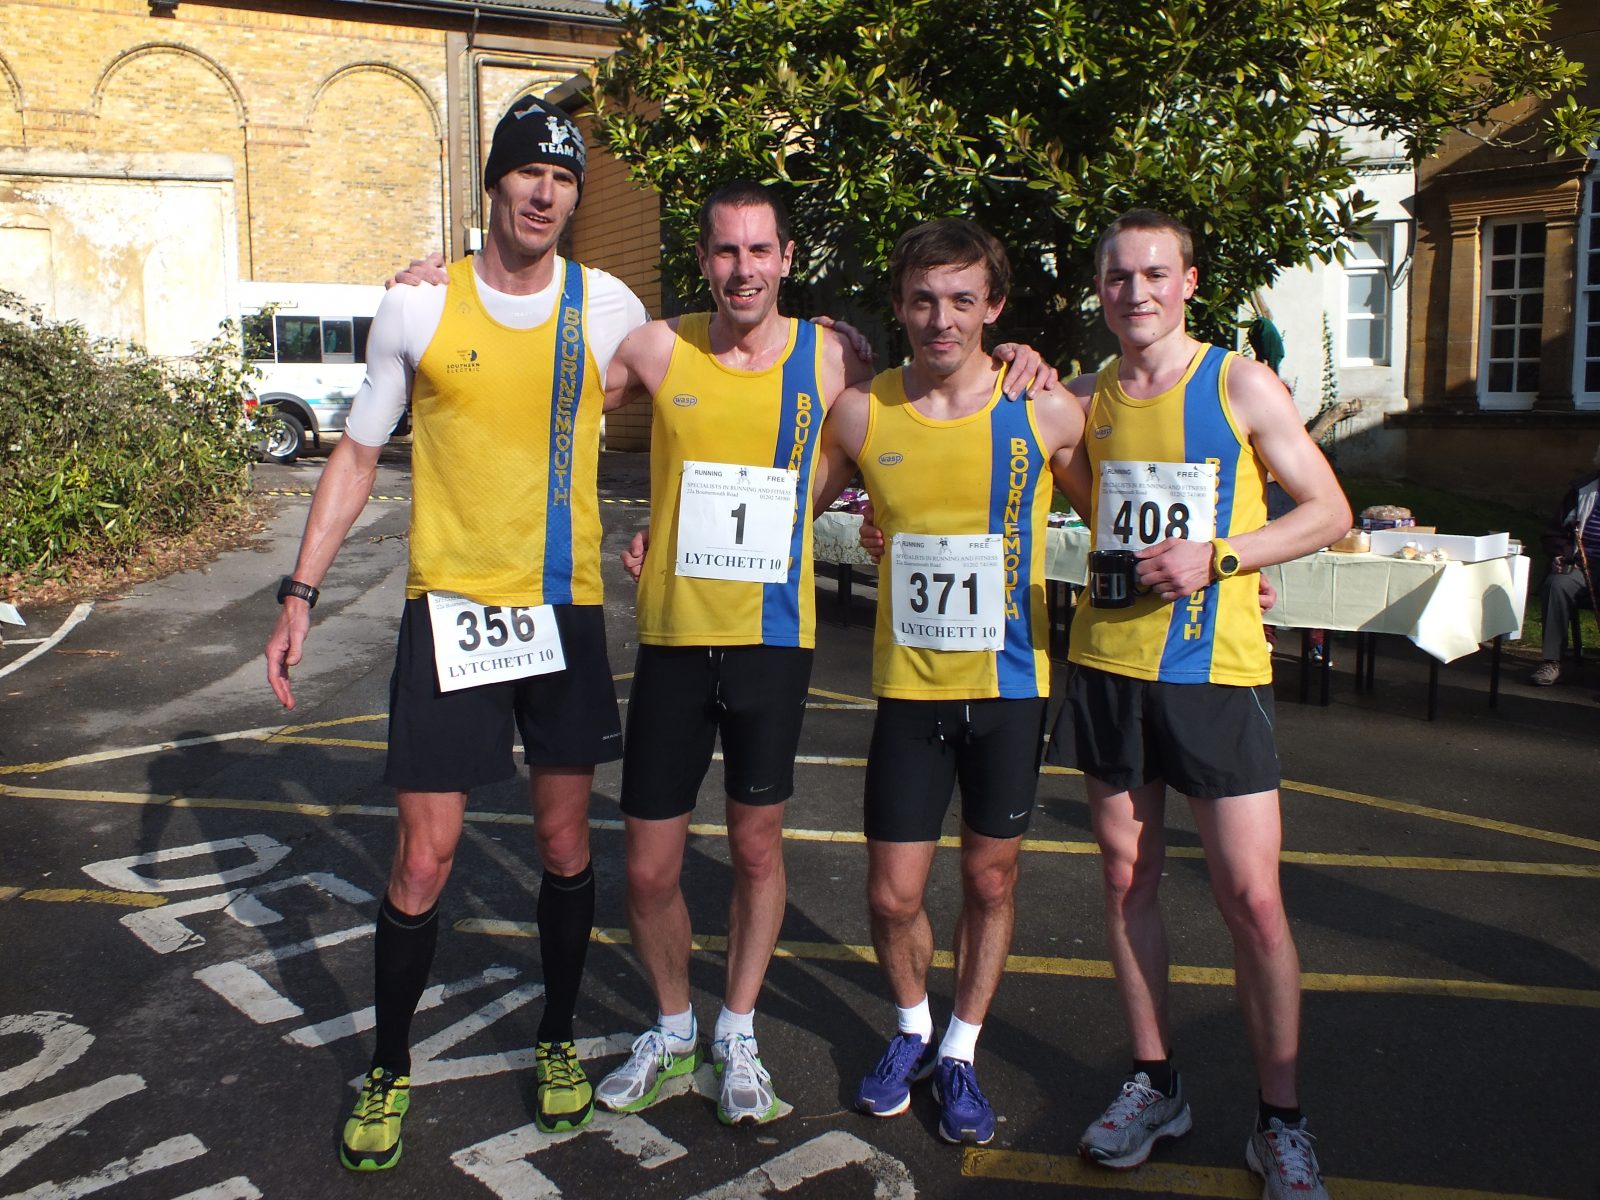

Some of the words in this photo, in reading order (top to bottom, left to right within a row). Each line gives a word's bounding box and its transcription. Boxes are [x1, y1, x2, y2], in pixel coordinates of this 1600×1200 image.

[538, 142, 574, 157] TEAM
[554, 306, 580, 506] BOURNEMOUTH
[694, 469, 723, 477] RUNNING
[767, 475, 785, 483] FREE
[730, 484, 757, 493] RUNNING
[731, 503, 747, 545] 1
[1003, 437, 1029, 620] BOURNEMOUTH
[1113, 500, 1190, 545] 408
[685, 552, 767, 569] LYTCHETT
[769, 558, 782, 570] 10
[910, 572, 978, 615] 371
[456, 606, 535, 652] 356
[901, 622, 978, 638] LYTCHETT
[982, 626, 997, 638] 10
[448, 652, 534, 678] LYTCHETT
[538, 648, 554, 662] 10
